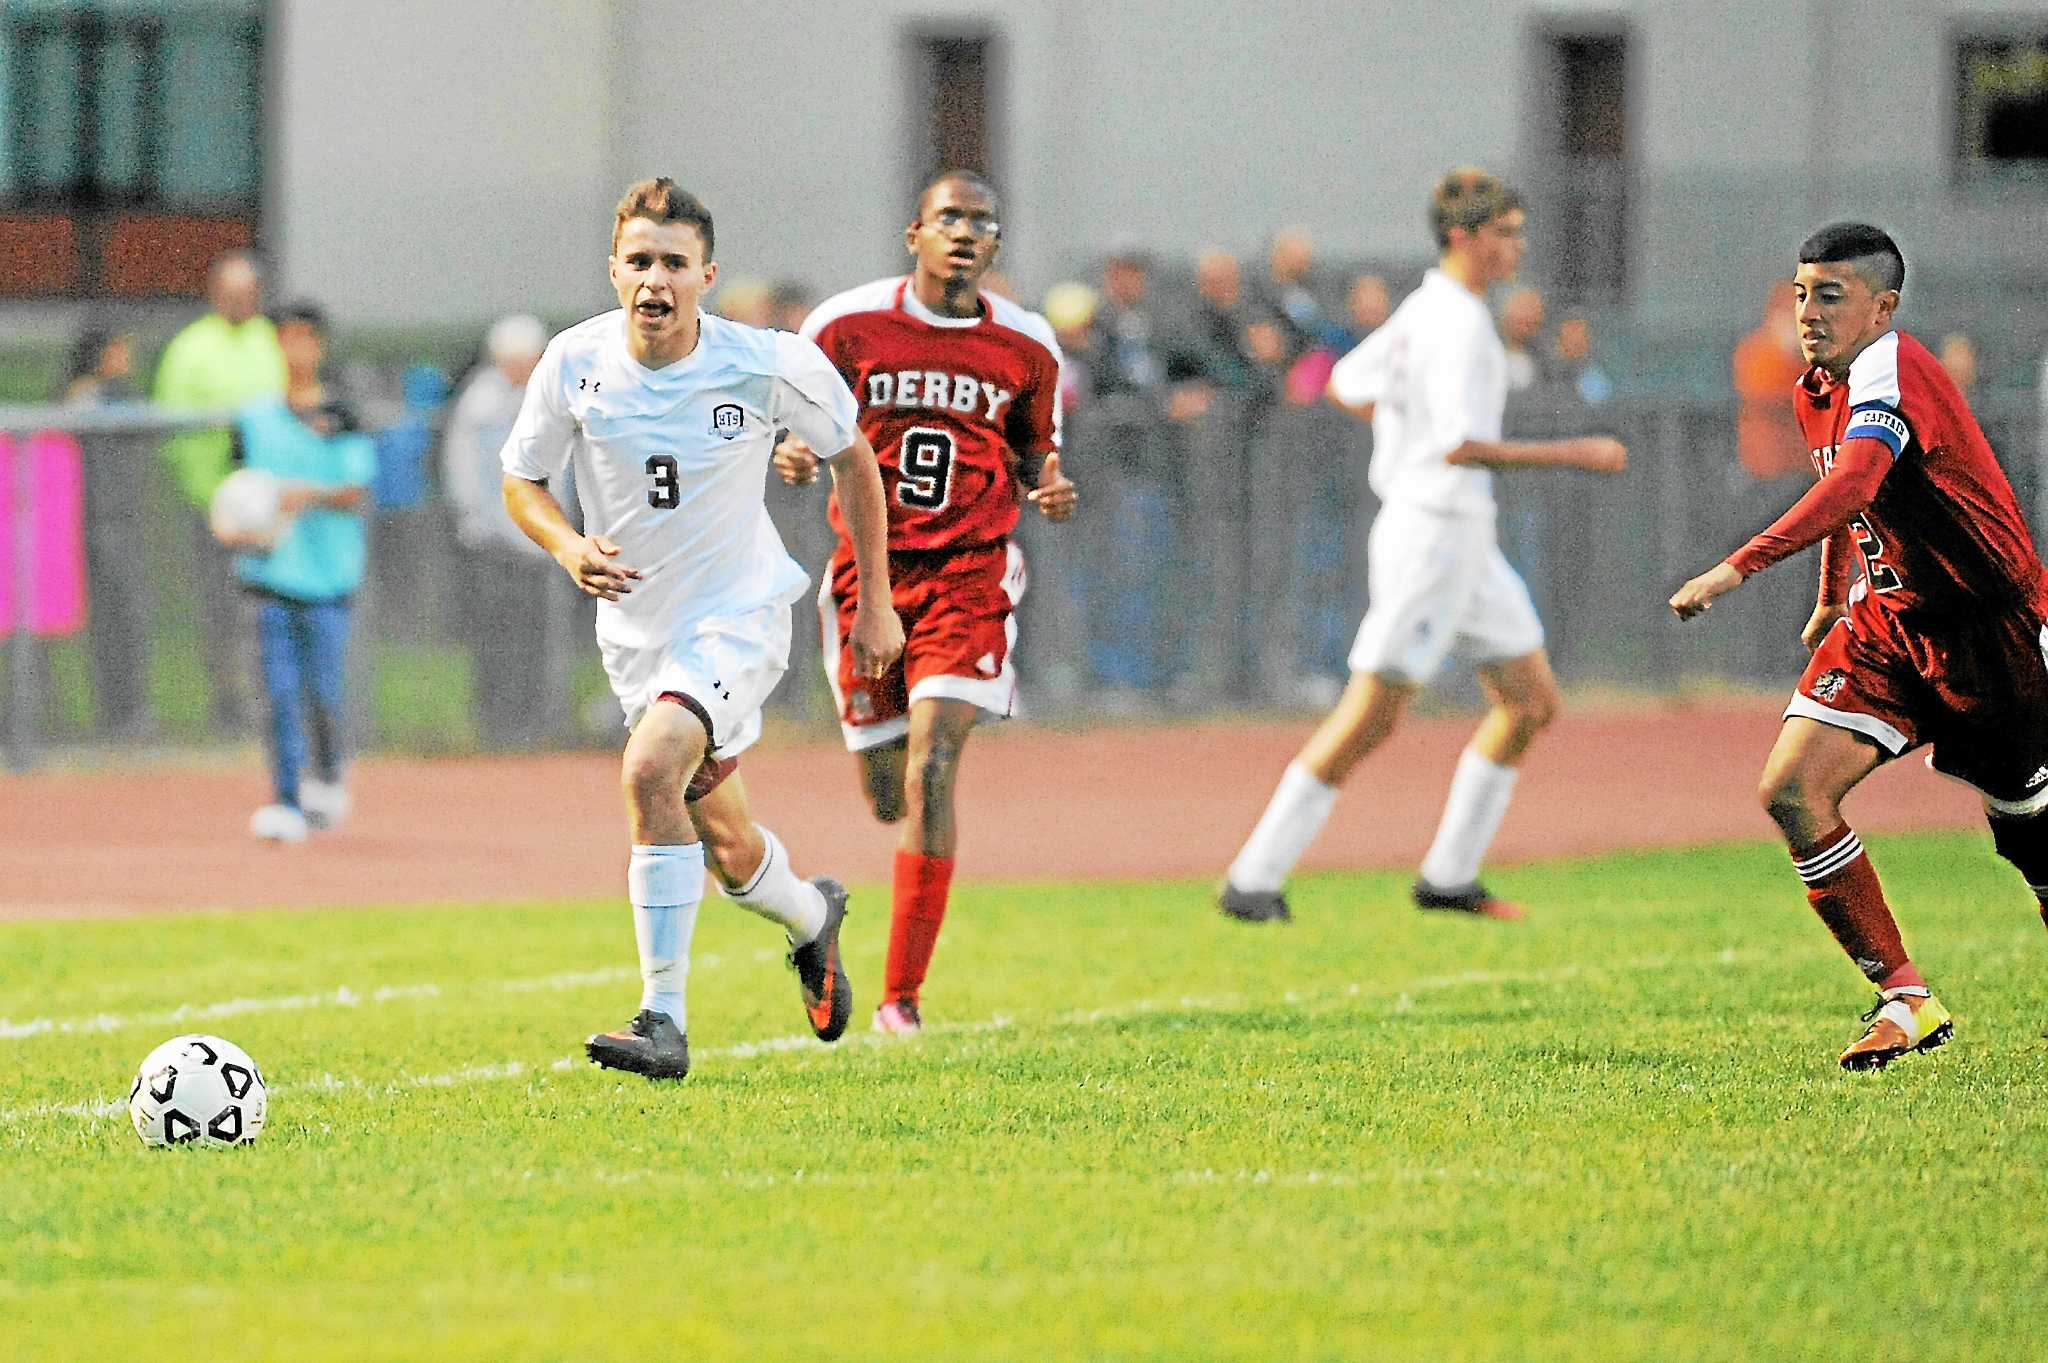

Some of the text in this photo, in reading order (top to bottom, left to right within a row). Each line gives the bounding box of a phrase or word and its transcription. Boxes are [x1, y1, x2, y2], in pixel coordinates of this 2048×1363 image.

[868, 371, 1011, 420] DERBY
[1864, 413, 1905, 436] CAPTAIN
[645, 454, 681, 510] 3
[896, 426, 957, 512] 9
